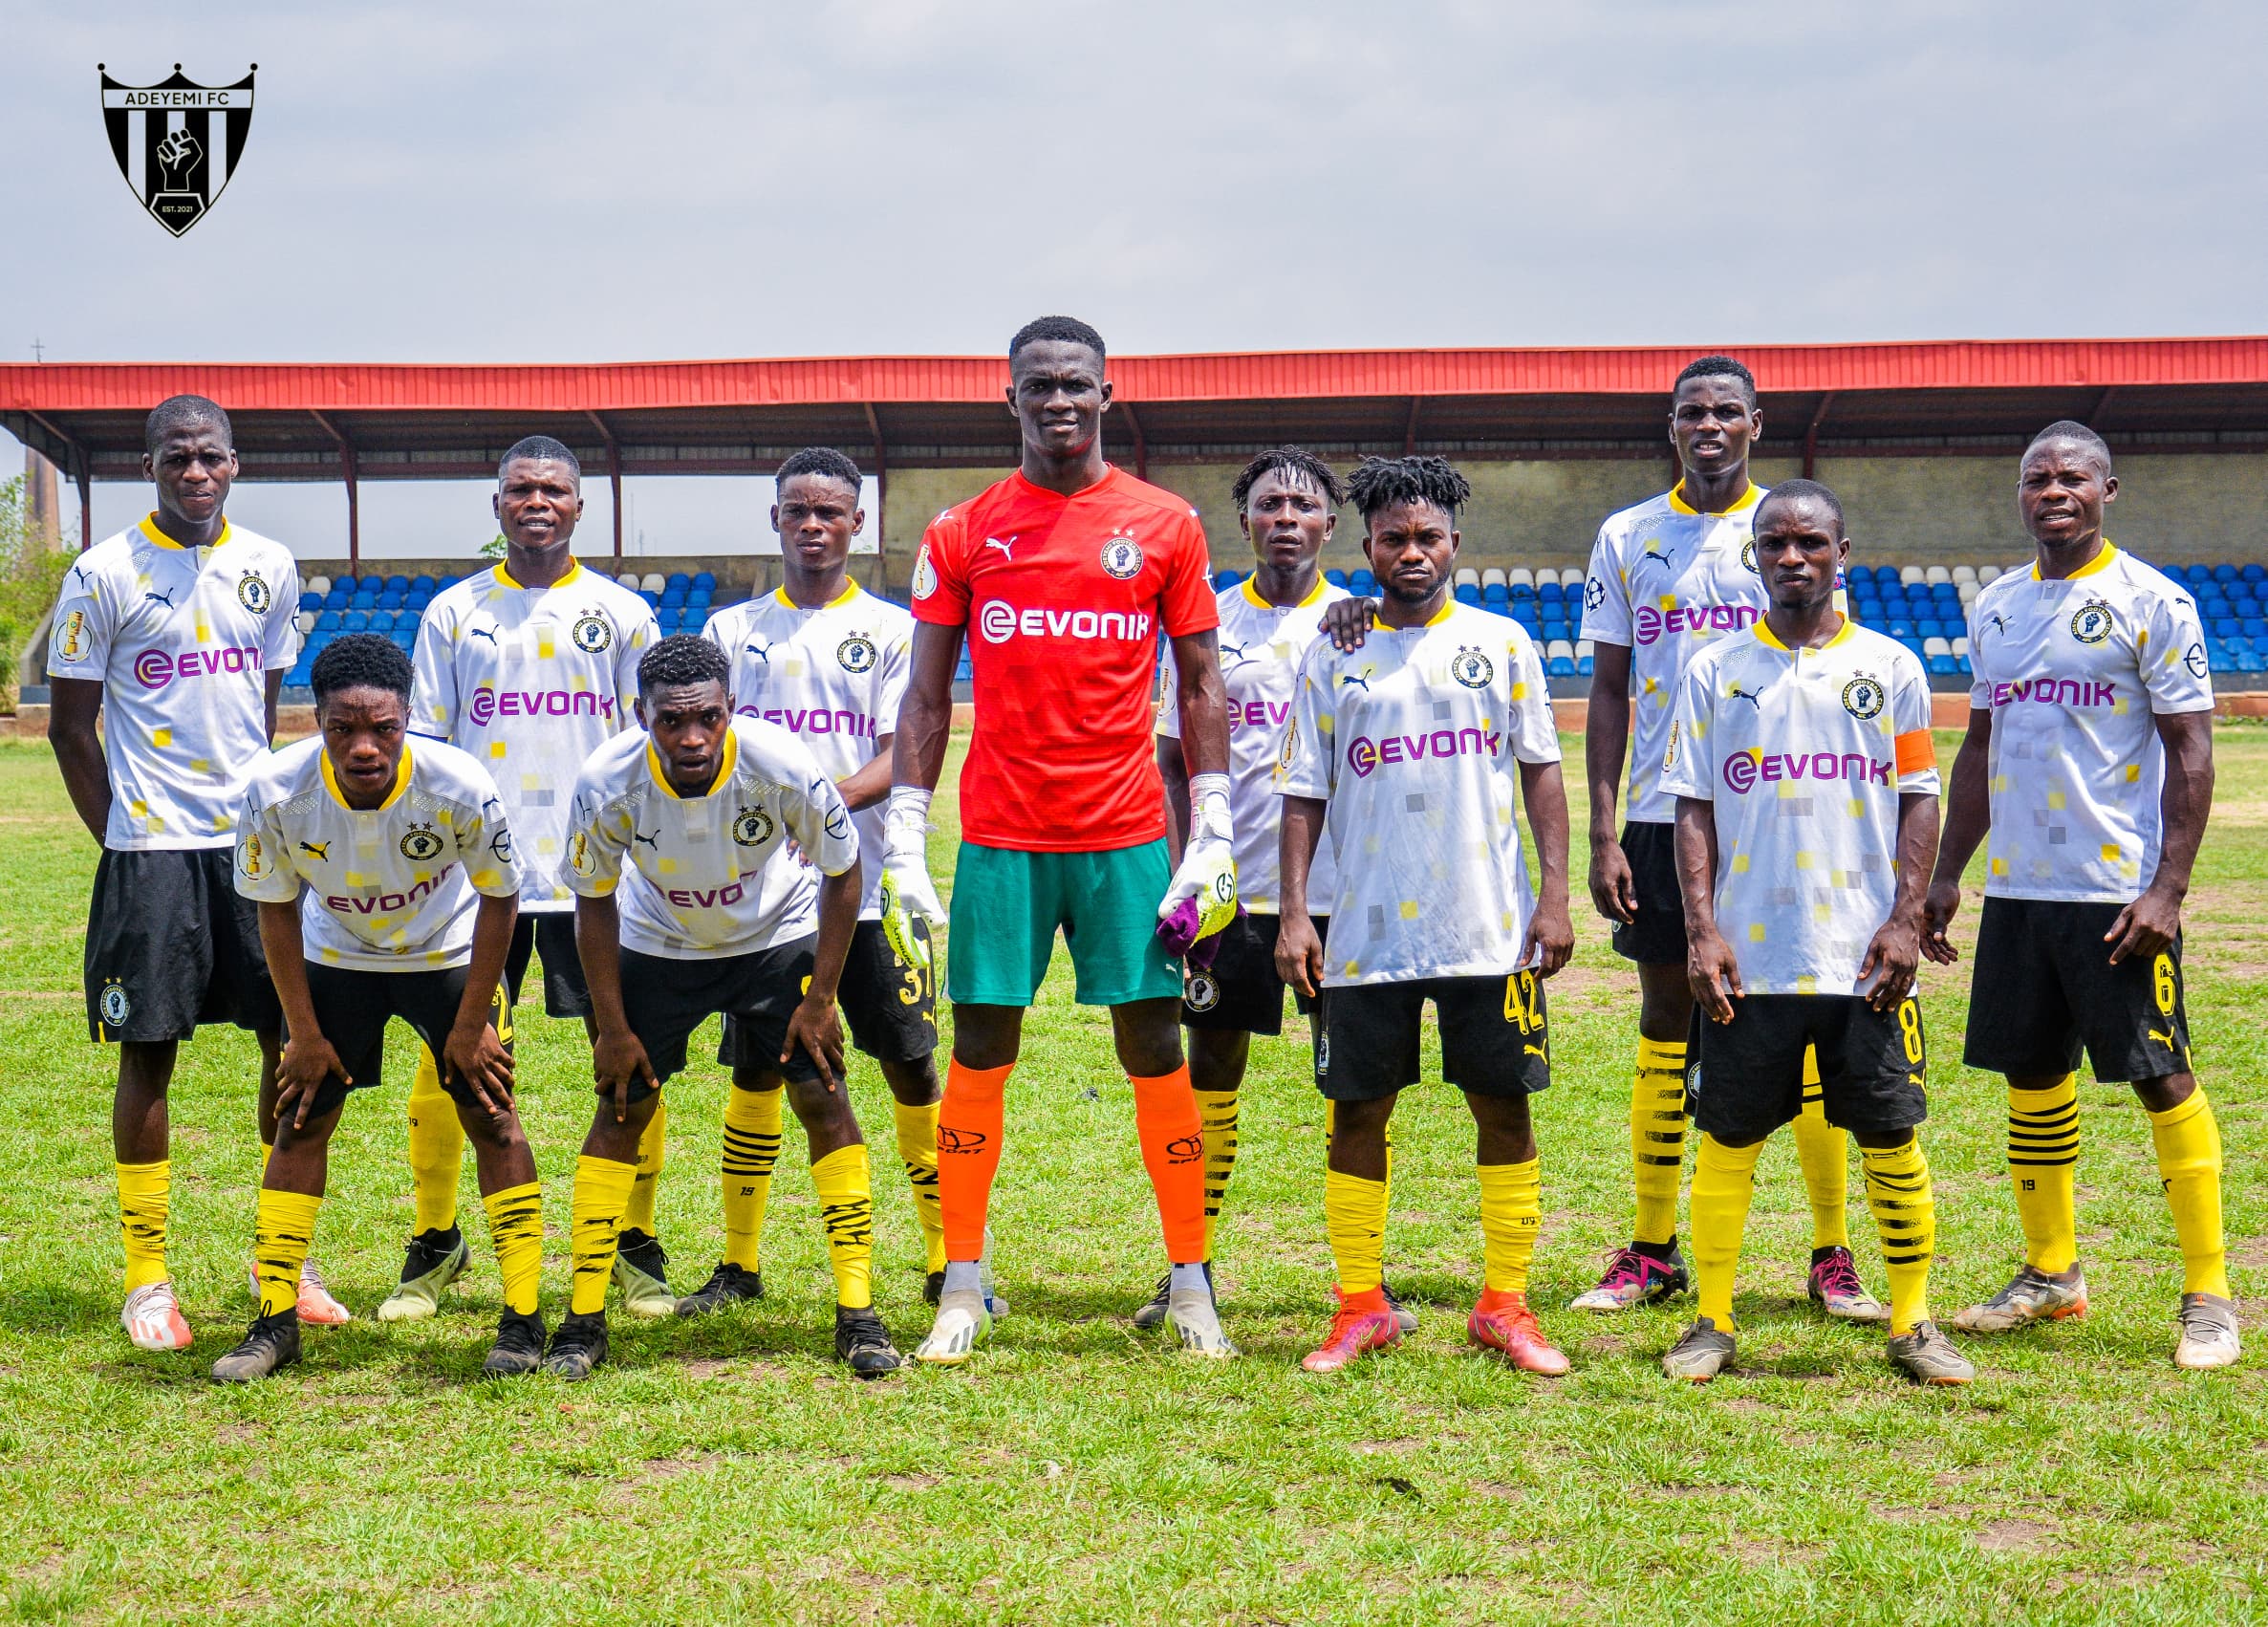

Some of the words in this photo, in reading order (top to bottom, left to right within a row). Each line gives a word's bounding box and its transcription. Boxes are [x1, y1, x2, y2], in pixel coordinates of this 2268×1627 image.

[1020, 609, 1150, 641] EVONIK
[498, 690, 615, 720] EVONK
[1995, 678, 2116, 706] EVONIK
[1379, 727, 1501, 765] EVONK
[1760, 752, 1893, 787] EVONK
[2153, 953, 2176, 1017] 6
[1503, 969, 1544, 1036] 42
[1898, 999, 1923, 1065] 8
[740, 1186, 755, 1196] 19
[2021, 1179, 2035, 1191] 19
